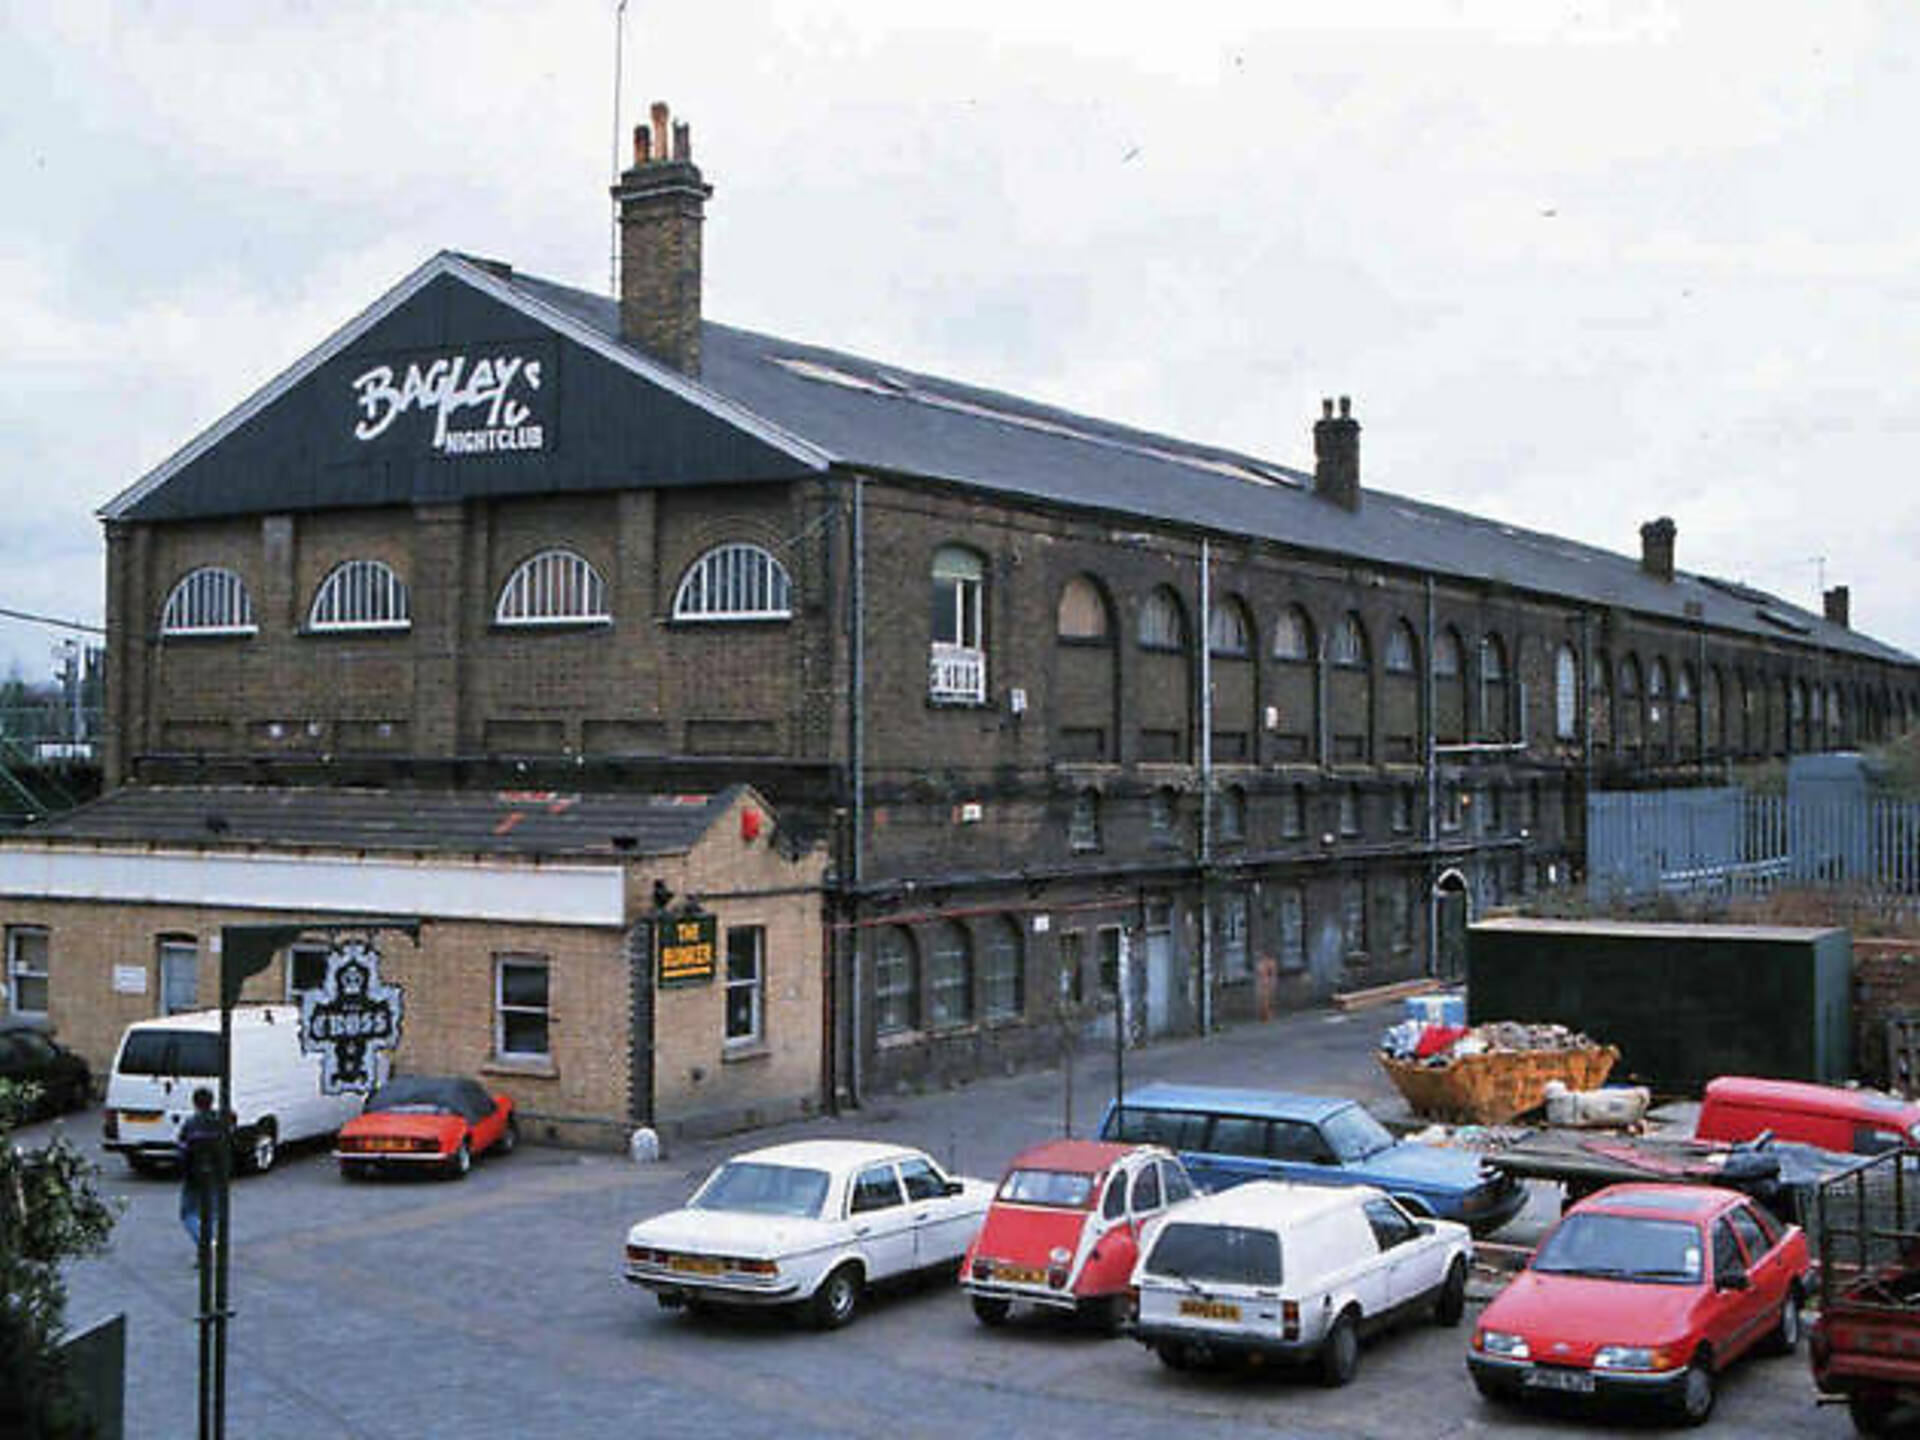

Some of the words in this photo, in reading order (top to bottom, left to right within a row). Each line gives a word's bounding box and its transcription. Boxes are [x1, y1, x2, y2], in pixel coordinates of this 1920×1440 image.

[445, 426, 543, 453] NIGHTCLUB
[677, 923, 699, 941] THE
[312, 1011, 388, 1038] CROSS
